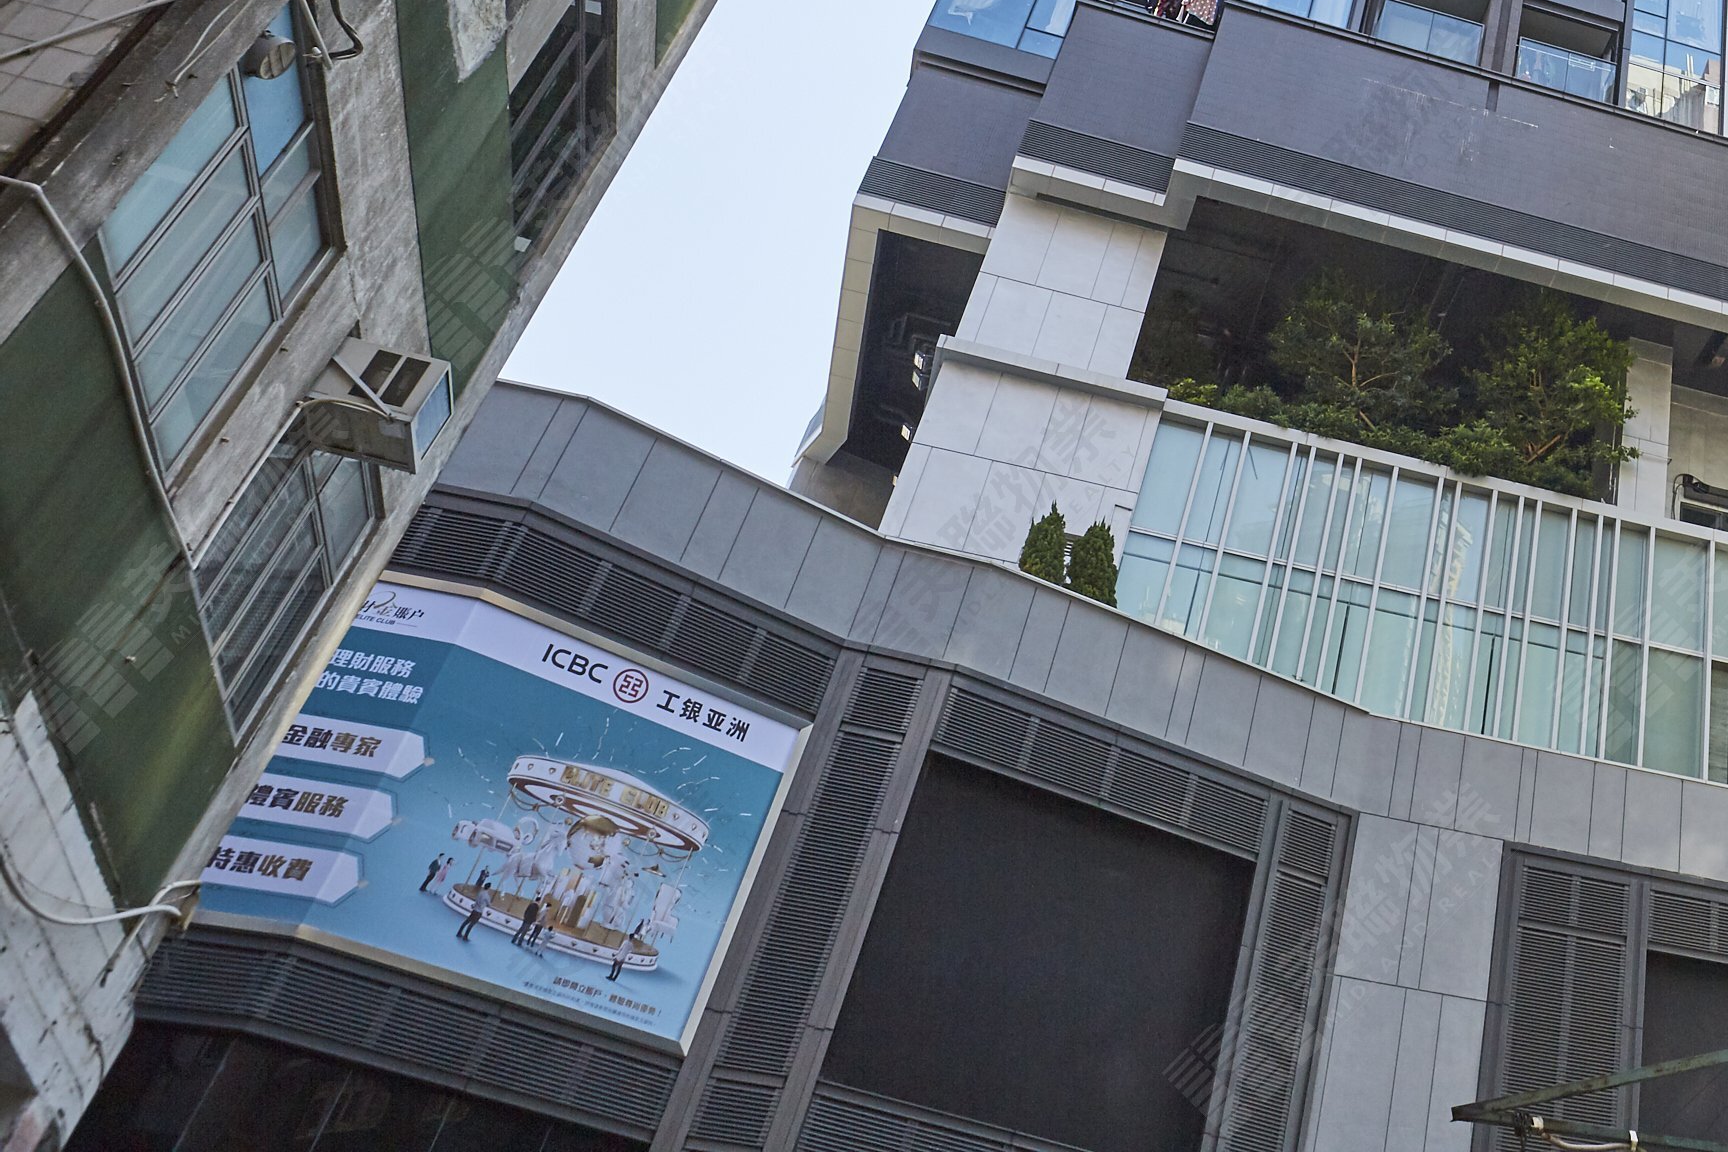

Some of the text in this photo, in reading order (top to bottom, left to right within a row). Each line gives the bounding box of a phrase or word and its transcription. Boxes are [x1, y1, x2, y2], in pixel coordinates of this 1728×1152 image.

[375, 616, 396, 626] CLUB
[328, 648, 417, 678] 理財服務
[541, 644, 609, 684] ICBC
[315, 670, 424, 704] 的貴賓體驗
[656, 689, 751, 743] 工银亚洲
[281, 724, 383, 758] 金融專家
